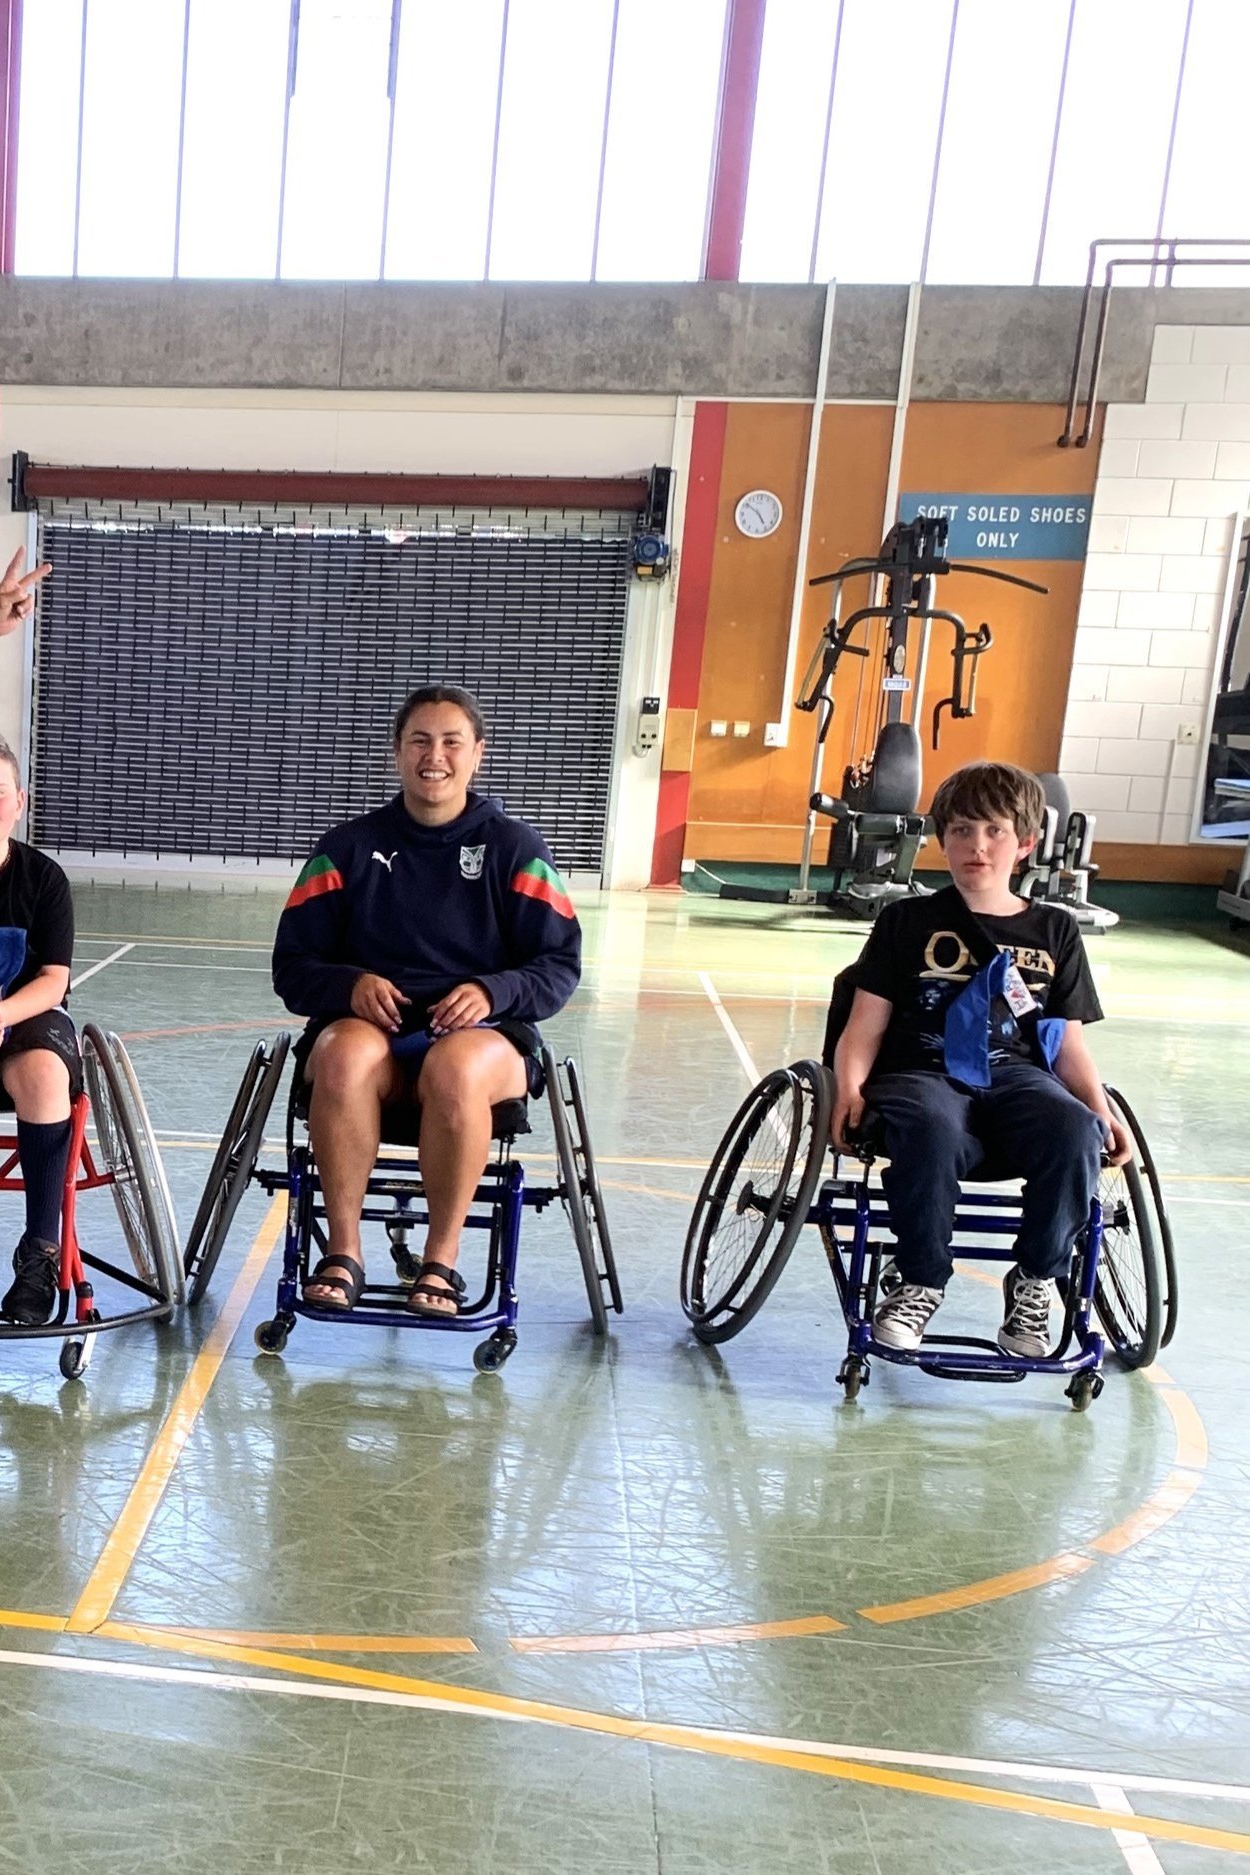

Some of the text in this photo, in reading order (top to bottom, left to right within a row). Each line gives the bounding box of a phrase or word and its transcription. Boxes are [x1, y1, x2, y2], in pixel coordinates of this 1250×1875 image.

[917, 505, 1086, 524] SOFT SOLED SHOES
[976, 532, 1020, 548] ONLY
[919, 931, 1056, 981] QEN
